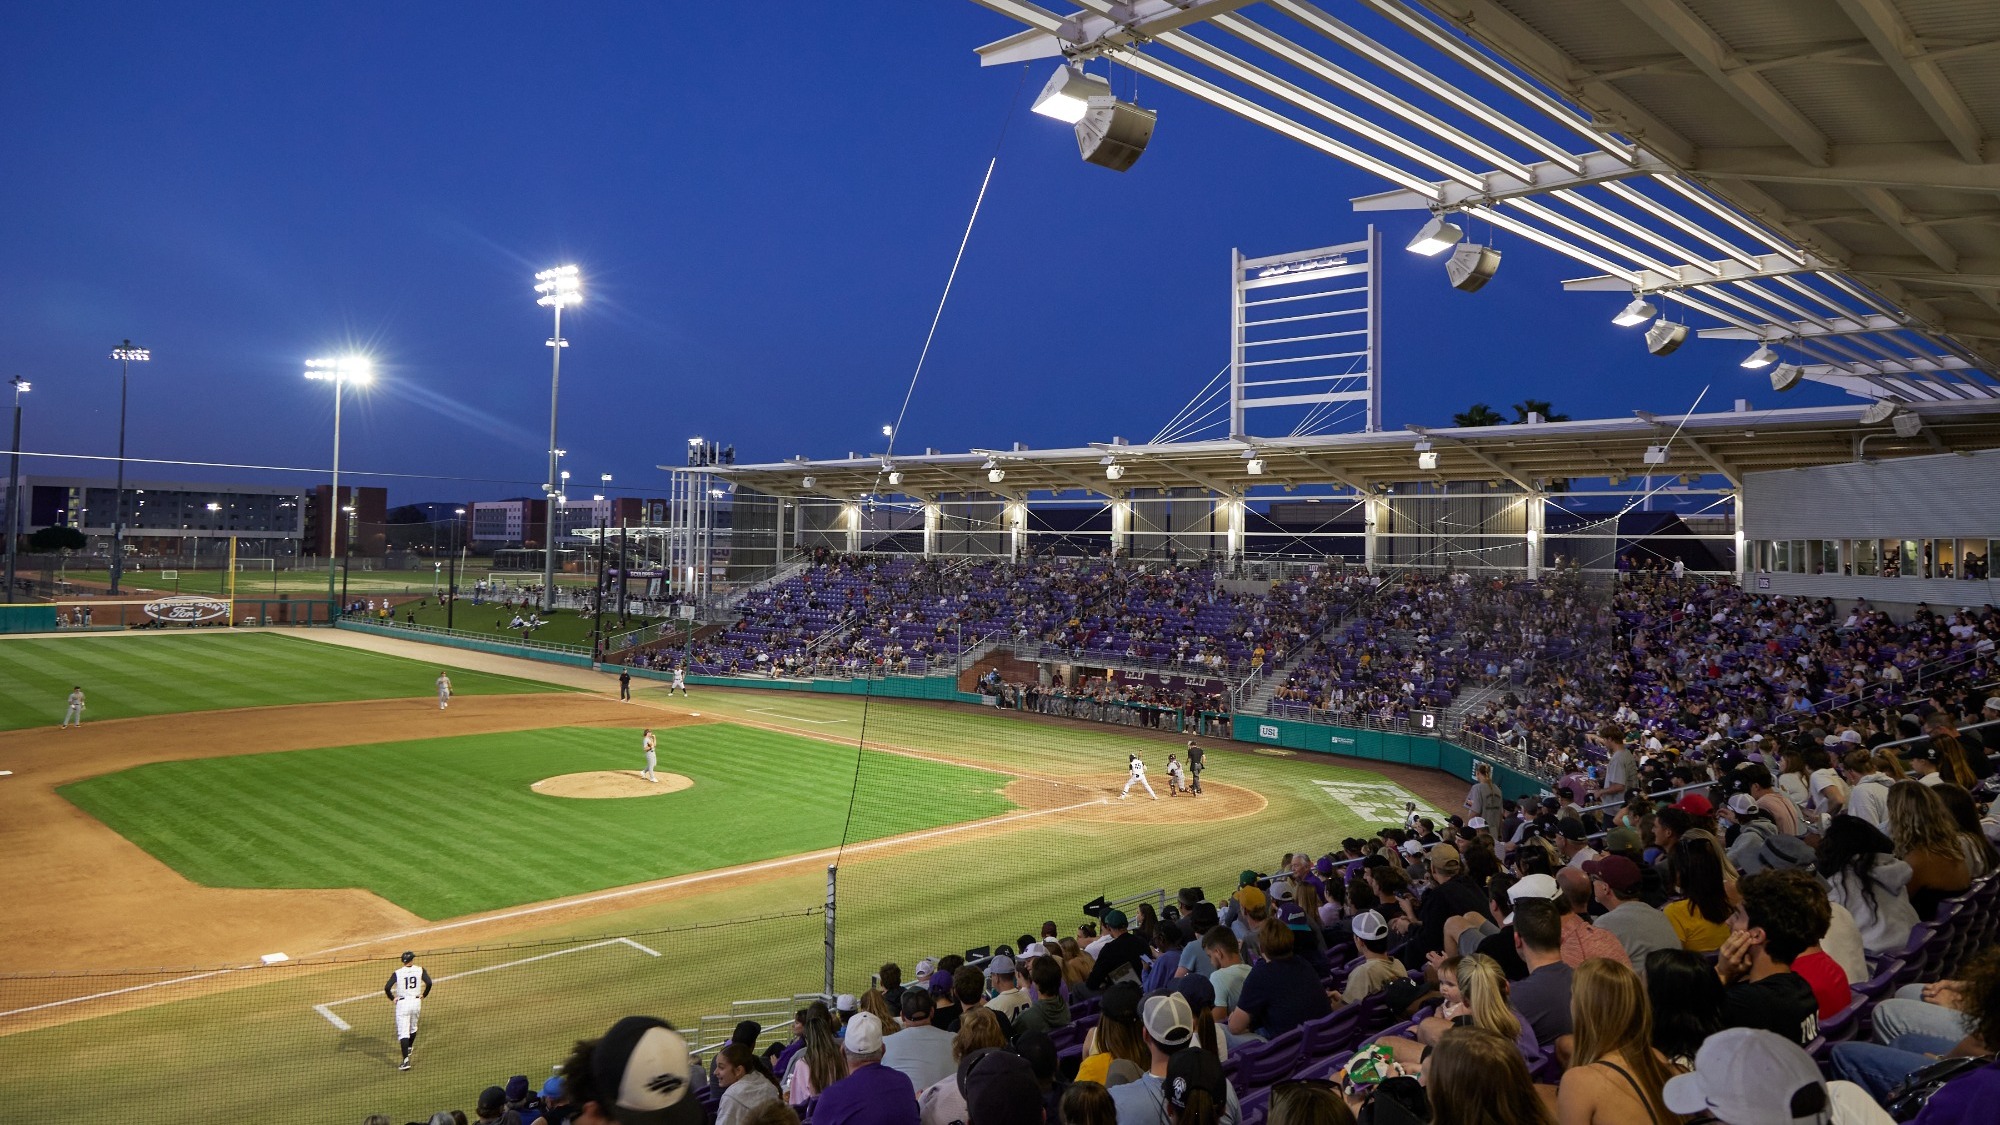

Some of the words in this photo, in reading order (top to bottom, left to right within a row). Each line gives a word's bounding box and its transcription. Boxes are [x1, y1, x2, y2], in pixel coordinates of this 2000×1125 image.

[169, 607, 202, 617] Ford
[1422, 715, 1433, 727] 13
[404, 976, 416, 989] 19
